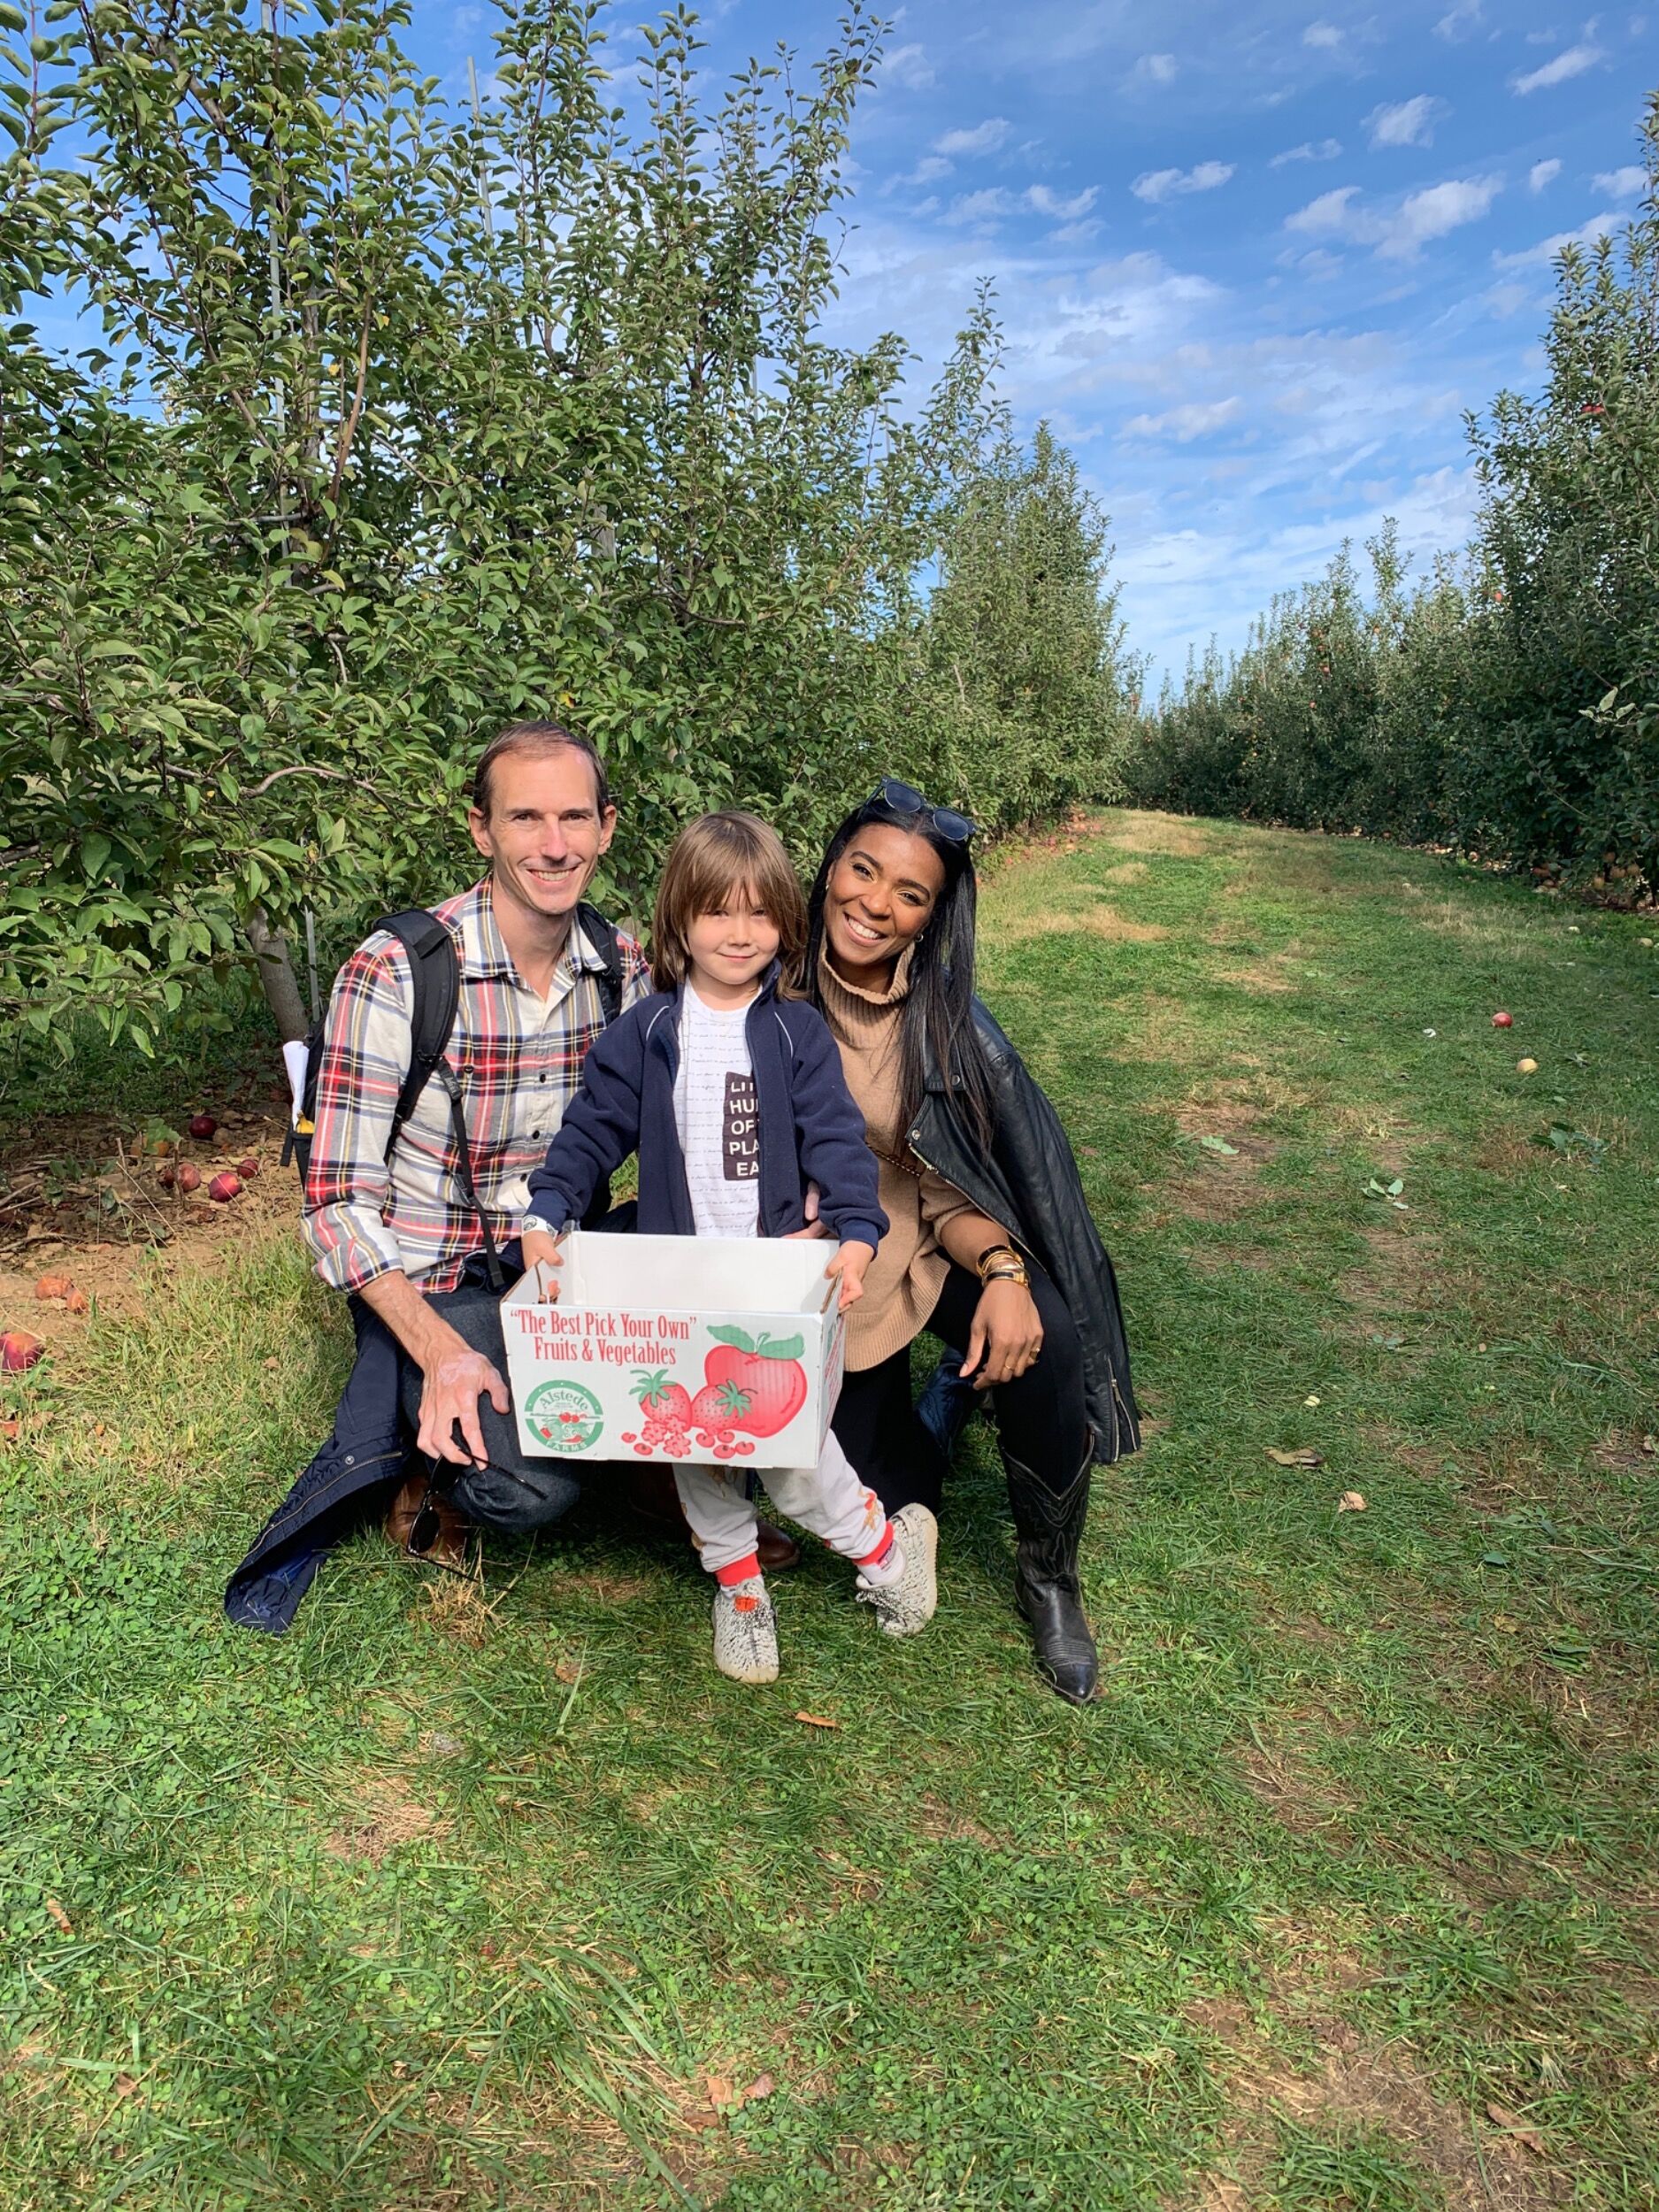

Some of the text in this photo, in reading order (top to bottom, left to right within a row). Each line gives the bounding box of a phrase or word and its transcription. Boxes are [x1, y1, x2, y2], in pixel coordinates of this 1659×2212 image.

[730, 1098, 758, 1115] HU
[731, 1119, 755, 1135] OF
[550, 1310, 581, 1335] Best
[586, 1311, 618, 1337] Pick
[620, 1313, 655, 1338] Your
[534, 1336, 677, 1366] Fruits & Vegetables
[540, 1390, 588, 1410] Alstede
[545, 1440, 588, 1452] FARMS
